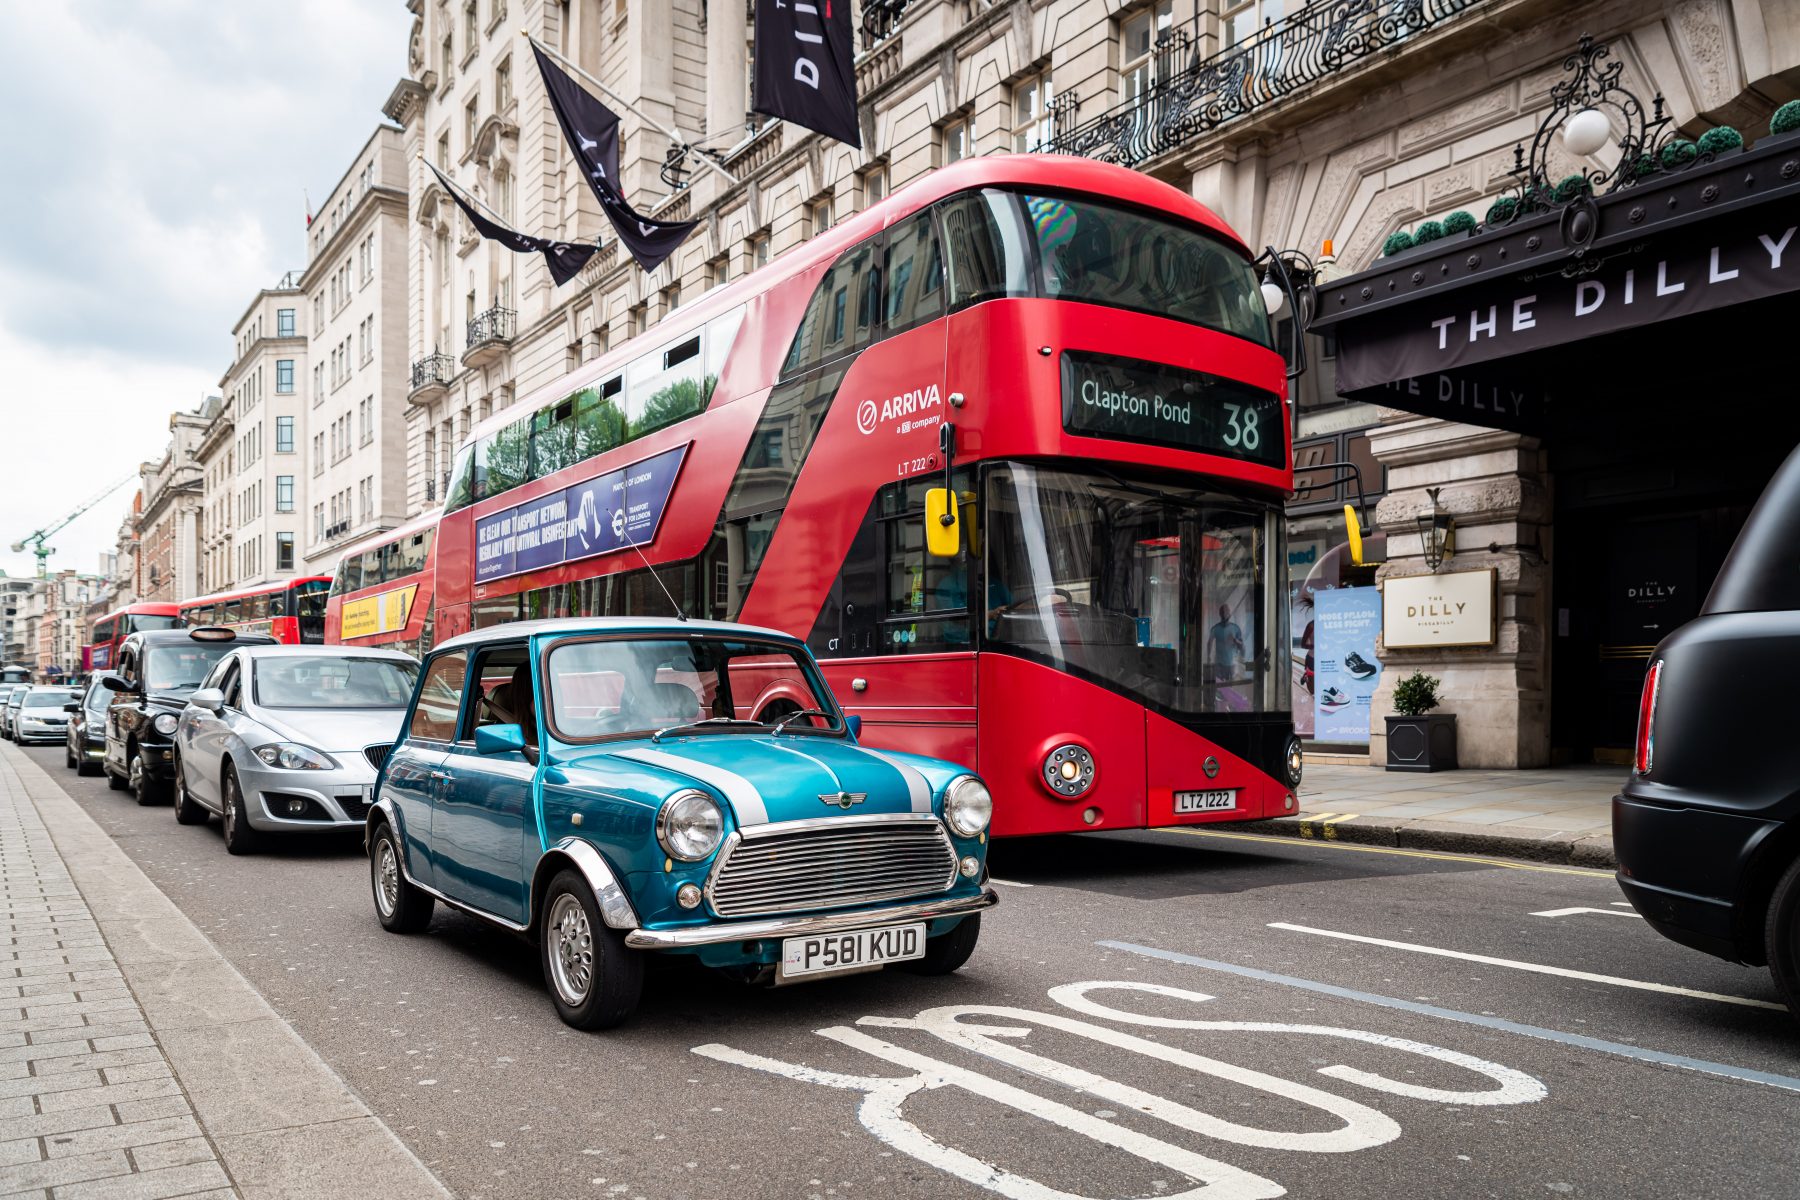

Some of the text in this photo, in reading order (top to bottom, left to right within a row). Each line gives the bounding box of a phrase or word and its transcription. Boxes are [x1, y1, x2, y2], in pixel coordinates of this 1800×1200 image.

[1431, 226, 1798, 350] THE DILLY
[880, 383, 941, 423] ARRIVA
[1081, 379, 1191, 425] Clapton Pond
[1438, 374, 1524, 417] DILLY
[911, 414, 941, 429] company
[1222, 402, 1260, 451] 38
[898, 457, 926, 476] LT 222
[1407, 602, 1466, 618] DILLY
[1628, 586, 1676, 598] DILLY
[828, 638, 839, 650] CT
[804, 928, 917, 970] P581 KUD
